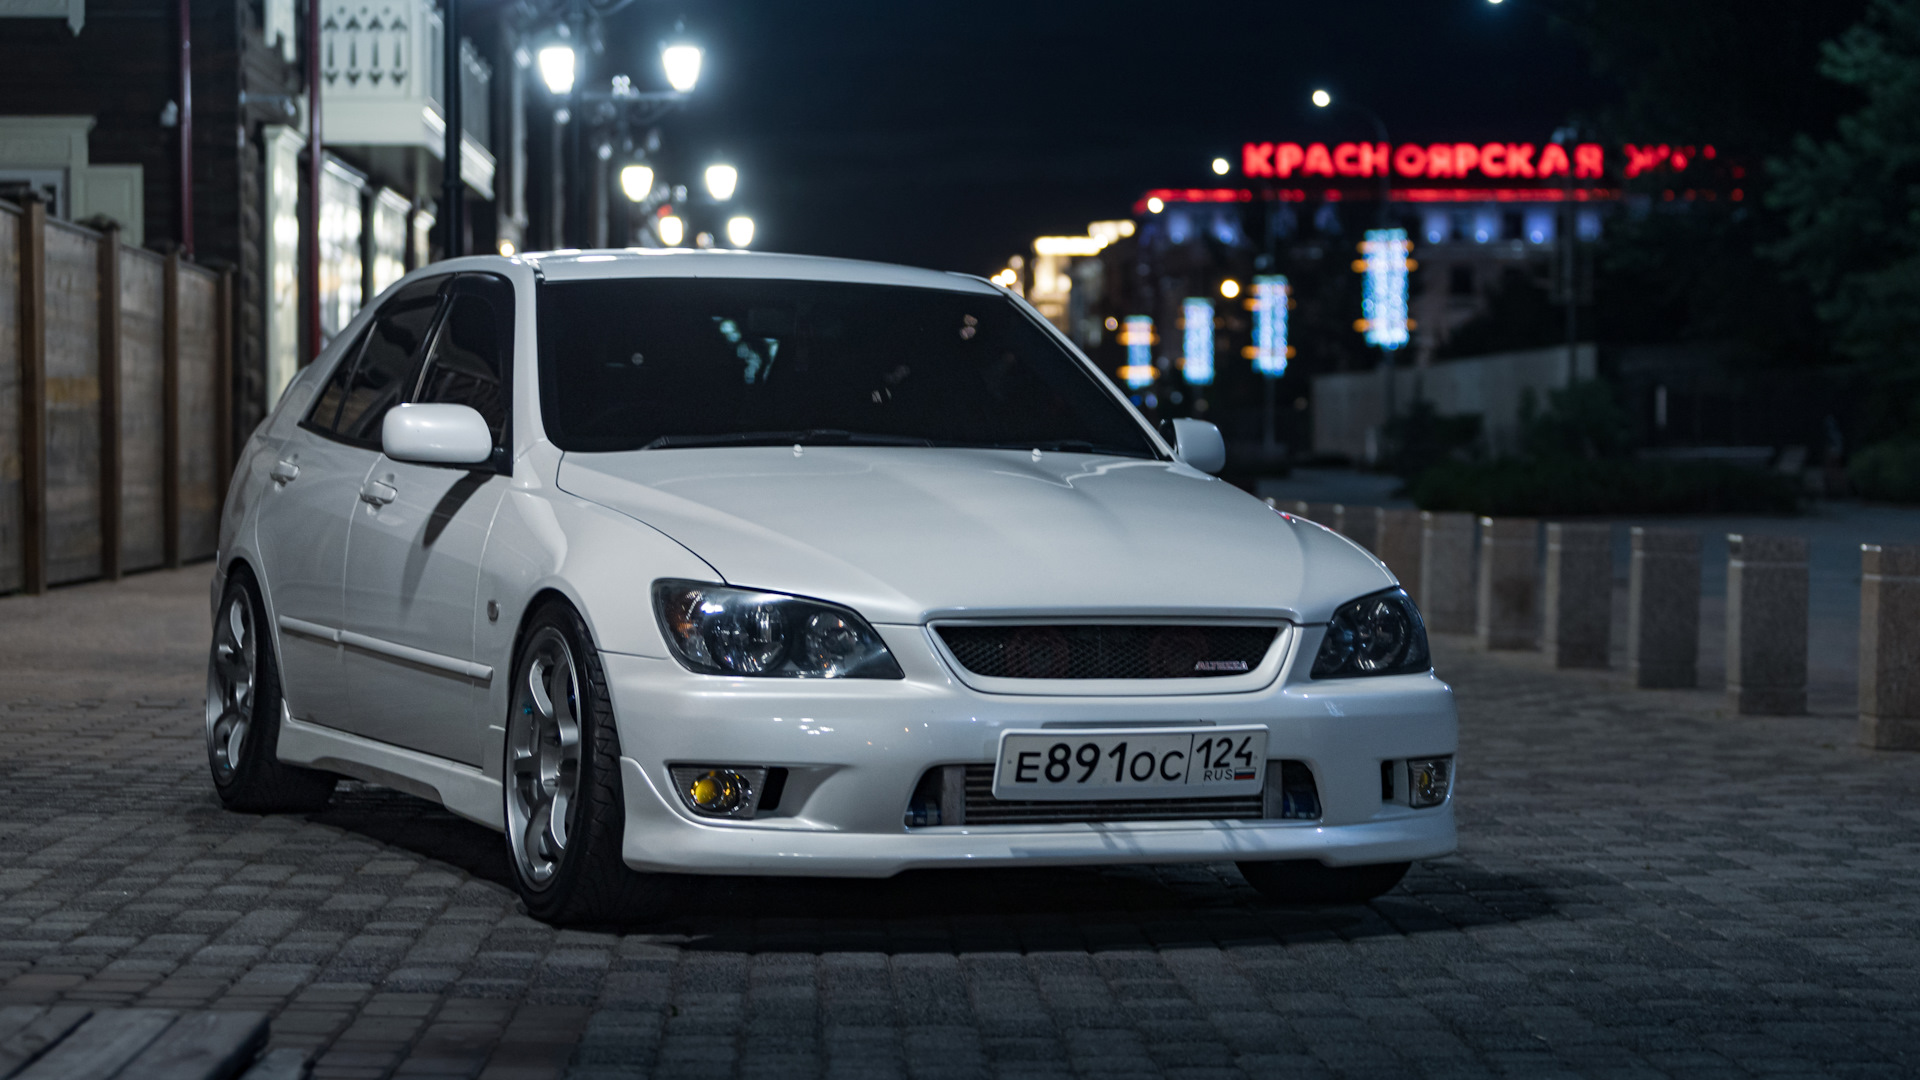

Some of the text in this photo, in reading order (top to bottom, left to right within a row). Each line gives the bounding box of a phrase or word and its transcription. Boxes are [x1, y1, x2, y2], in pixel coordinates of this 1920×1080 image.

[1243, 142, 1603, 178] КРАСНОЯРСКАЯ
[1196, 736, 1253, 769] 124
[1204, 768, 1234, 782] RUS
